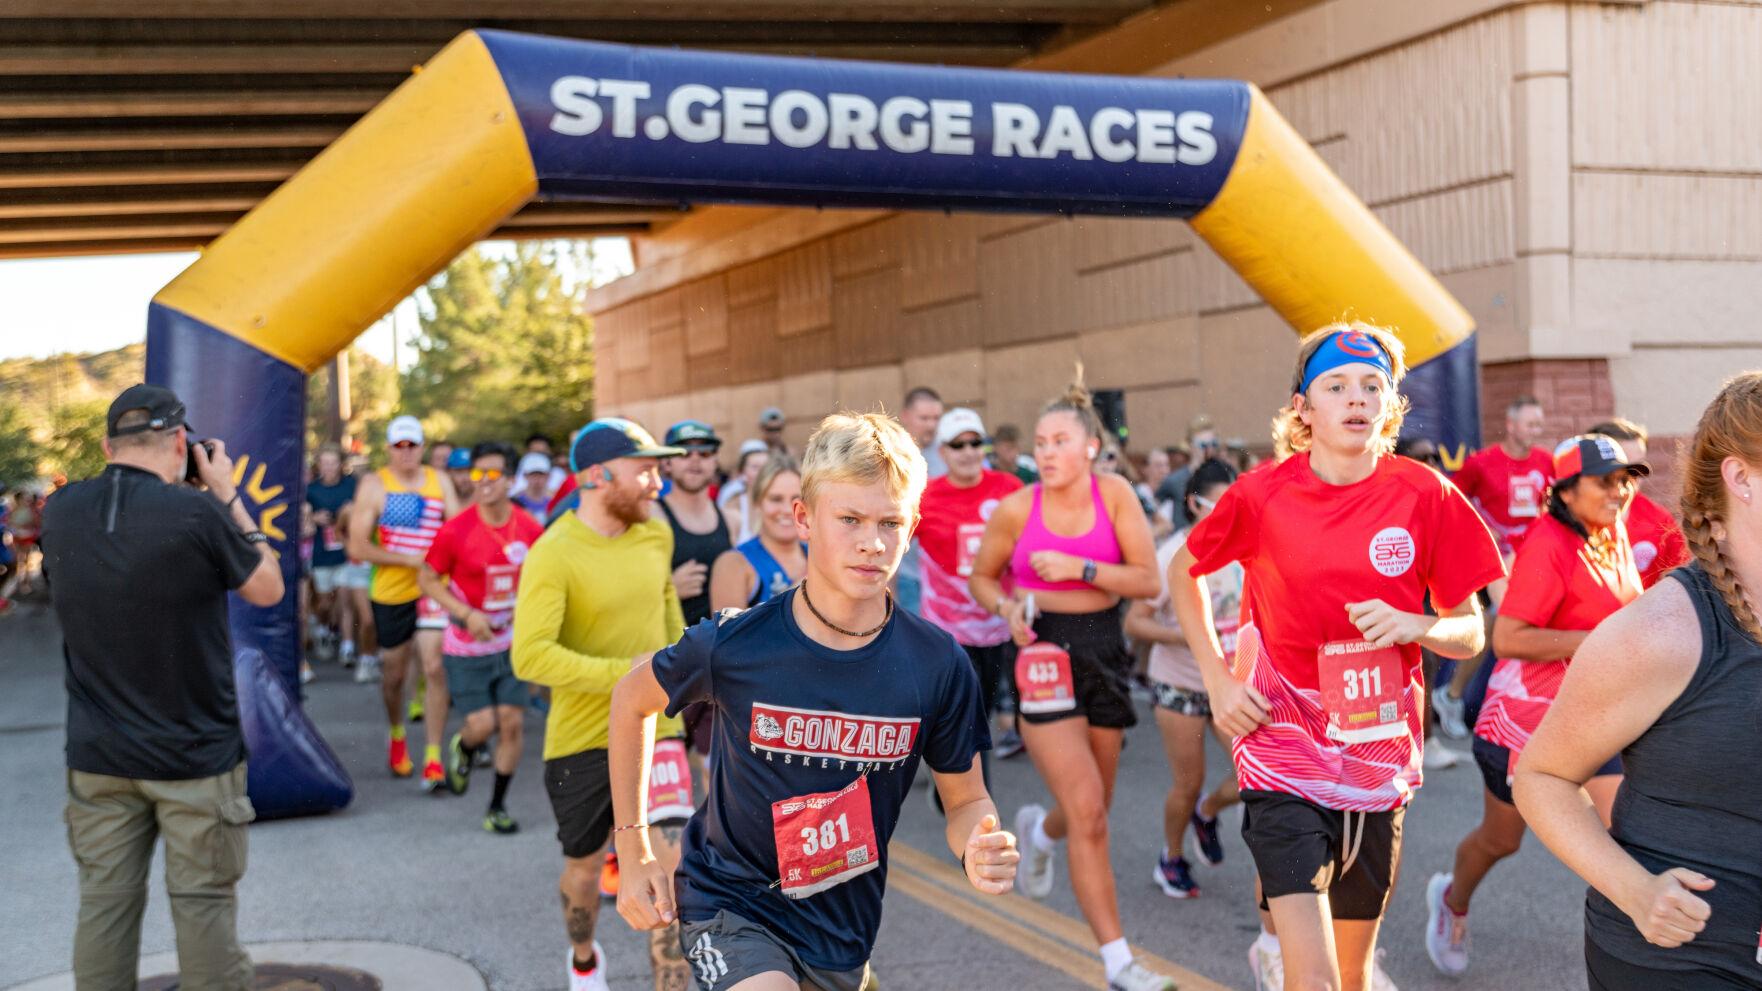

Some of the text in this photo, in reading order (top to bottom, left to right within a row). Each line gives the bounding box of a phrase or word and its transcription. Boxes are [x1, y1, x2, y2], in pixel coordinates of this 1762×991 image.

[549, 75, 1218, 166] ST.GEORGE RACES
[1343, 666, 1382, 701] 311
[783, 715, 912, 756] GONZAGA
[800, 812, 850, 857] 381
[788, 867, 803, 881] 5K
